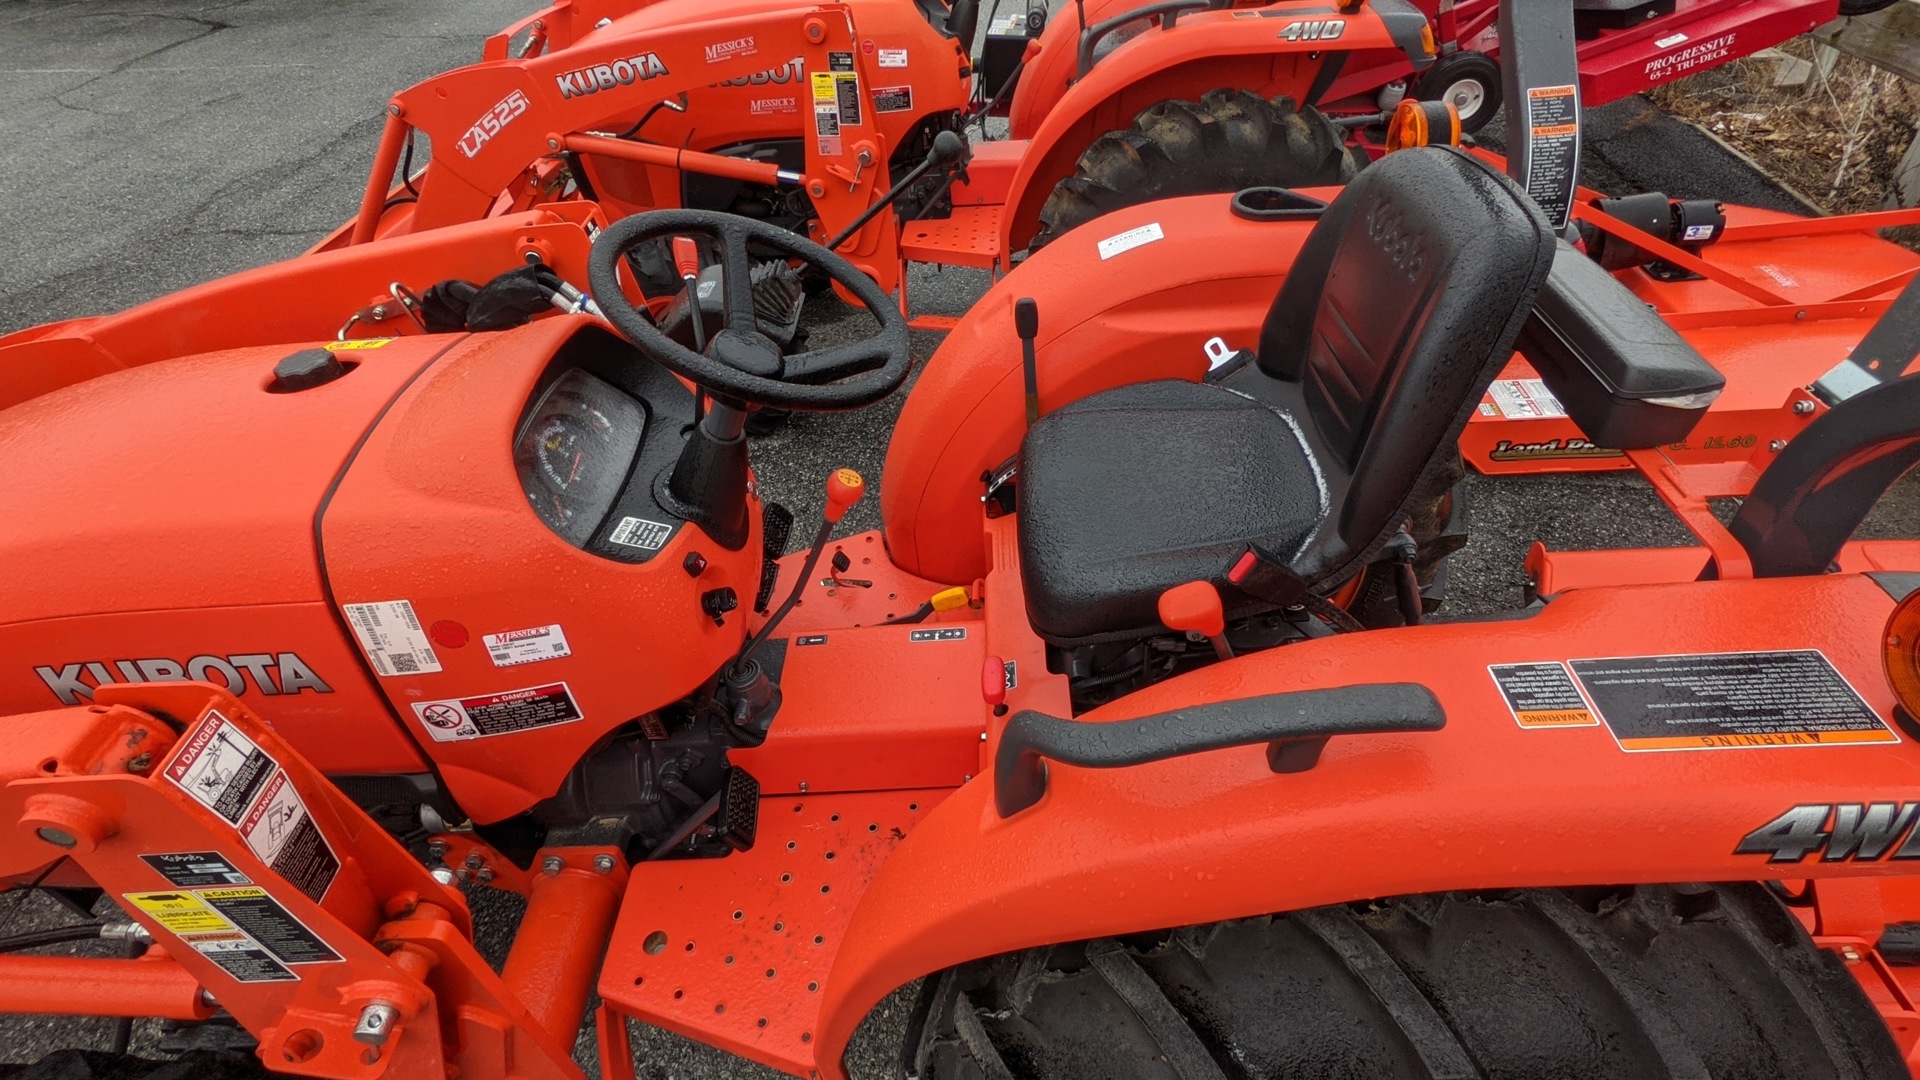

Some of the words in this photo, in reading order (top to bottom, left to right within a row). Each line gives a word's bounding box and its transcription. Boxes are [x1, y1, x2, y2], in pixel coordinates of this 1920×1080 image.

[1278, 19, 1346, 41] 4WD
[705, 36, 755, 60] MESSICK'S
[1645, 33, 1736, 73] PROGRESSIVE
[1650, 67, 1672, 80] 65-2
[1675, 47, 1729, 72] TRI-DECK
[555, 51, 669, 99] KUBOTA
[750, 97, 796, 112] MESSICK'S
[459, 91, 528, 159] LA525
[1687, 226, 1701, 237] 3
[1495, 440, 1559, 456] Land
[495, 626, 550, 644] MESSICK'S
[33, 652, 335, 706] KUBOTA
[500, 690, 537, 700] DANGER
[1522, 713, 1578, 722] WARNING
[181, 716, 220, 765] DANGER
[1700, 734, 1805, 746] WARNING
[253, 777, 283, 821] DANGER
[160, 854, 205, 862] Kubota
[211, 889, 260, 897] CAUTION
[156, 910, 212, 918] LUBRICATE
